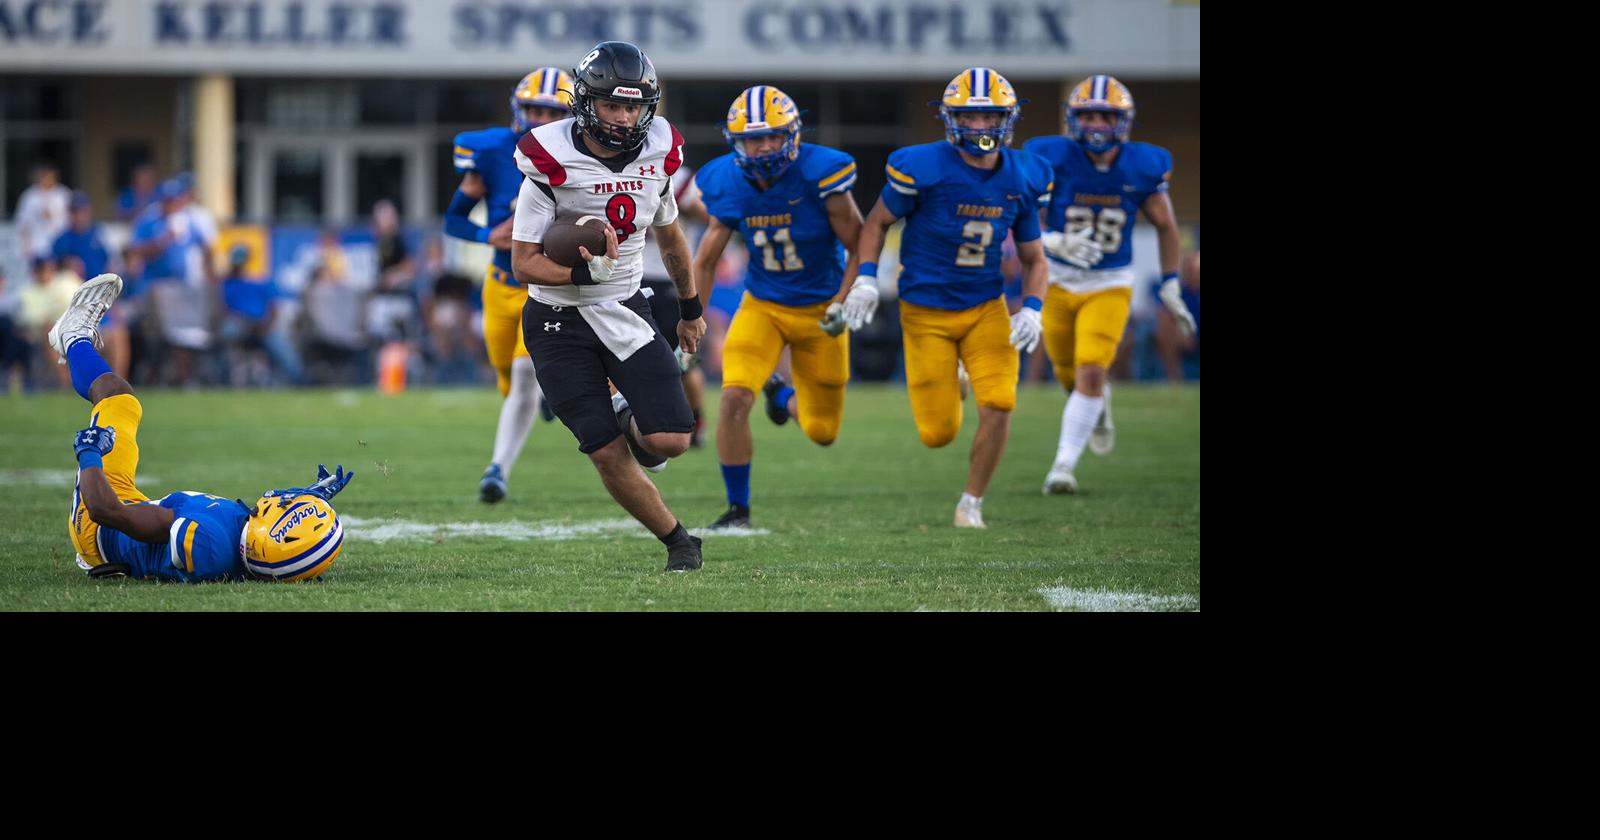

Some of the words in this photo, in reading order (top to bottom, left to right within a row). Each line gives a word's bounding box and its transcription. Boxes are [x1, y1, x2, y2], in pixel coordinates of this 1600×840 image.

[153, 1, 409, 47] KELLER
[450, 0, 704, 49] SPORTS
[741, 2, 1074, 52] COMPLEX
[578, 49, 600, 72] 8
[617, 88, 640, 96] Riddell
[594, 180, 643, 194] PIRATES
[605, 193, 637, 245] 8
[753, 227, 805, 272] 11
[955, 220, 994, 267] 2
[268, 501, 328, 544] Tarpons
